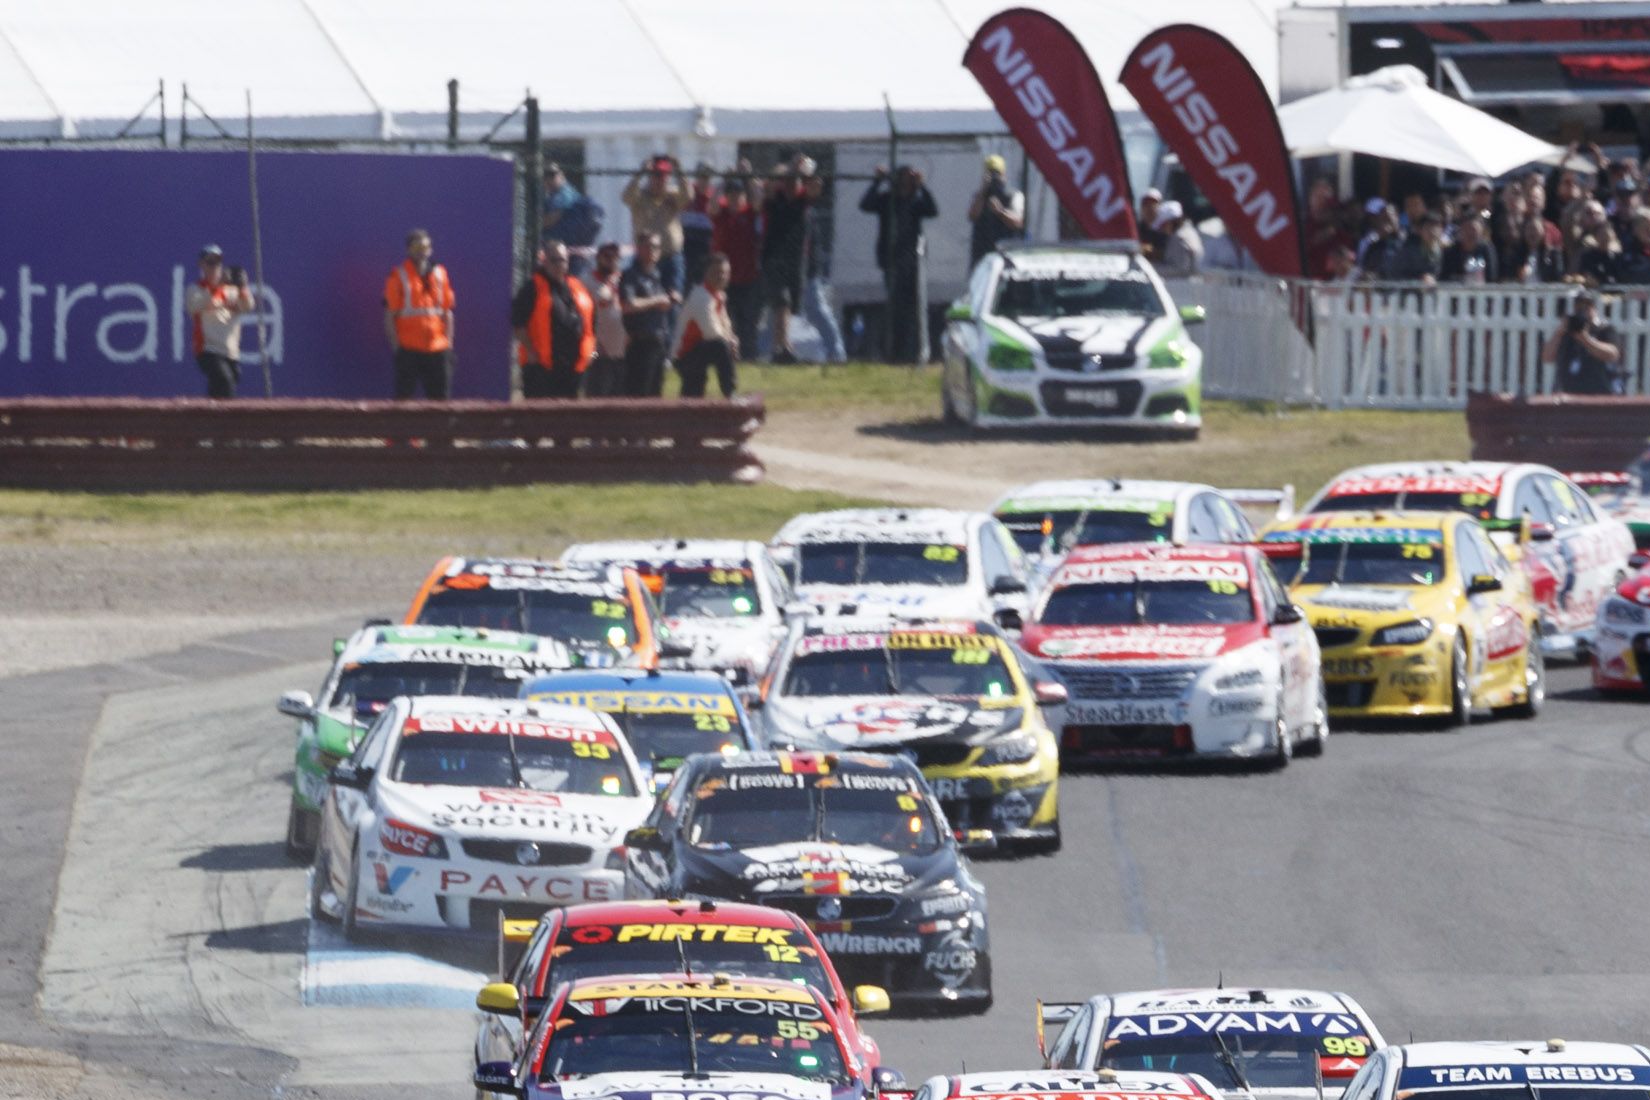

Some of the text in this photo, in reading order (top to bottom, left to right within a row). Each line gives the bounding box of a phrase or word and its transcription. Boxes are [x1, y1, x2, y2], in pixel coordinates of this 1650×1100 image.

[982, 25, 1126, 223] NISSAN
[1140, 42, 1289, 240] NISSAN
[0, 265, 283, 363] trala
[1065, 703, 1166, 723] Steadfast
[571, 741, 611, 760] 33
[439, 869, 610, 902] PAYCE
[616, 923, 793, 945] PIRTEK
[763, 945, 801, 963] 12
[633, 997, 823, 1020] TICKFORD
[777, 1020, 819, 1041] 55
[1108, 1012, 1301, 1039] ADVAM
[1322, 1037, 1366, 1057] 99
[1430, 1066, 1635, 1083] TEAM EREBUS
